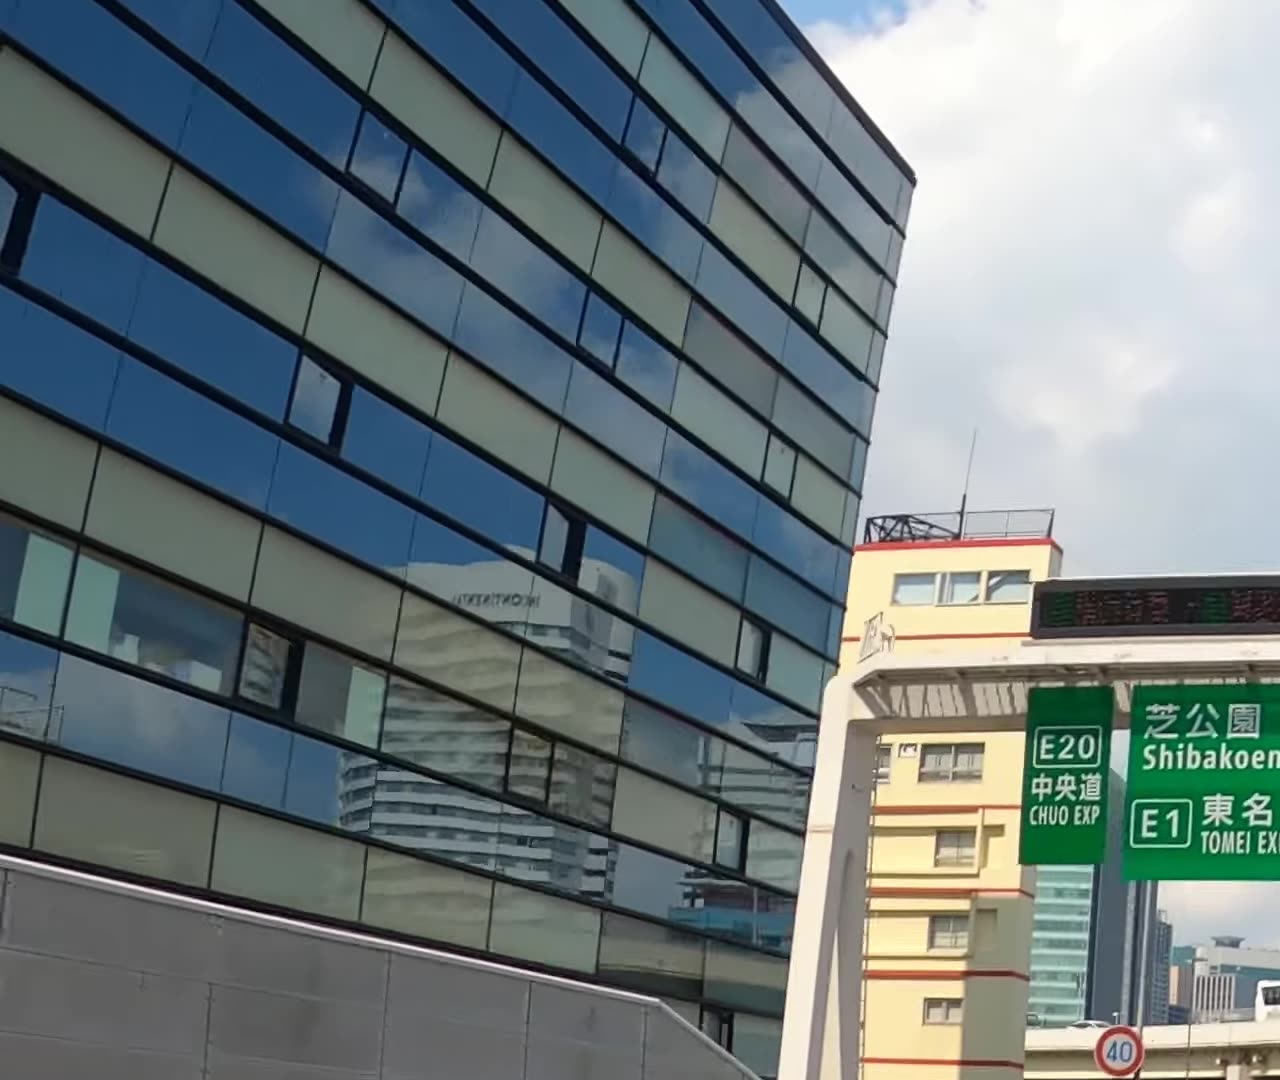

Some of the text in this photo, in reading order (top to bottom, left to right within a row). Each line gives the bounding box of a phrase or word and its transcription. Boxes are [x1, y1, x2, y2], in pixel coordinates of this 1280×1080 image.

[1144, 704, 1260, 739] 芝公園
[1040, 735, 1095, 759] E20
[1143, 744, 1280, 769] Shibakoen
[1032, 773, 1101, 801] 中央道
[1029, 805, 1100, 826] CHUO EXP
[1203, 793, 1272, 826] 東名
[1142, 809, 1178, 837] E1
[1201, 831, 1250, 853] TOMEI
[1107, 1041, 1132, 1062] 40
